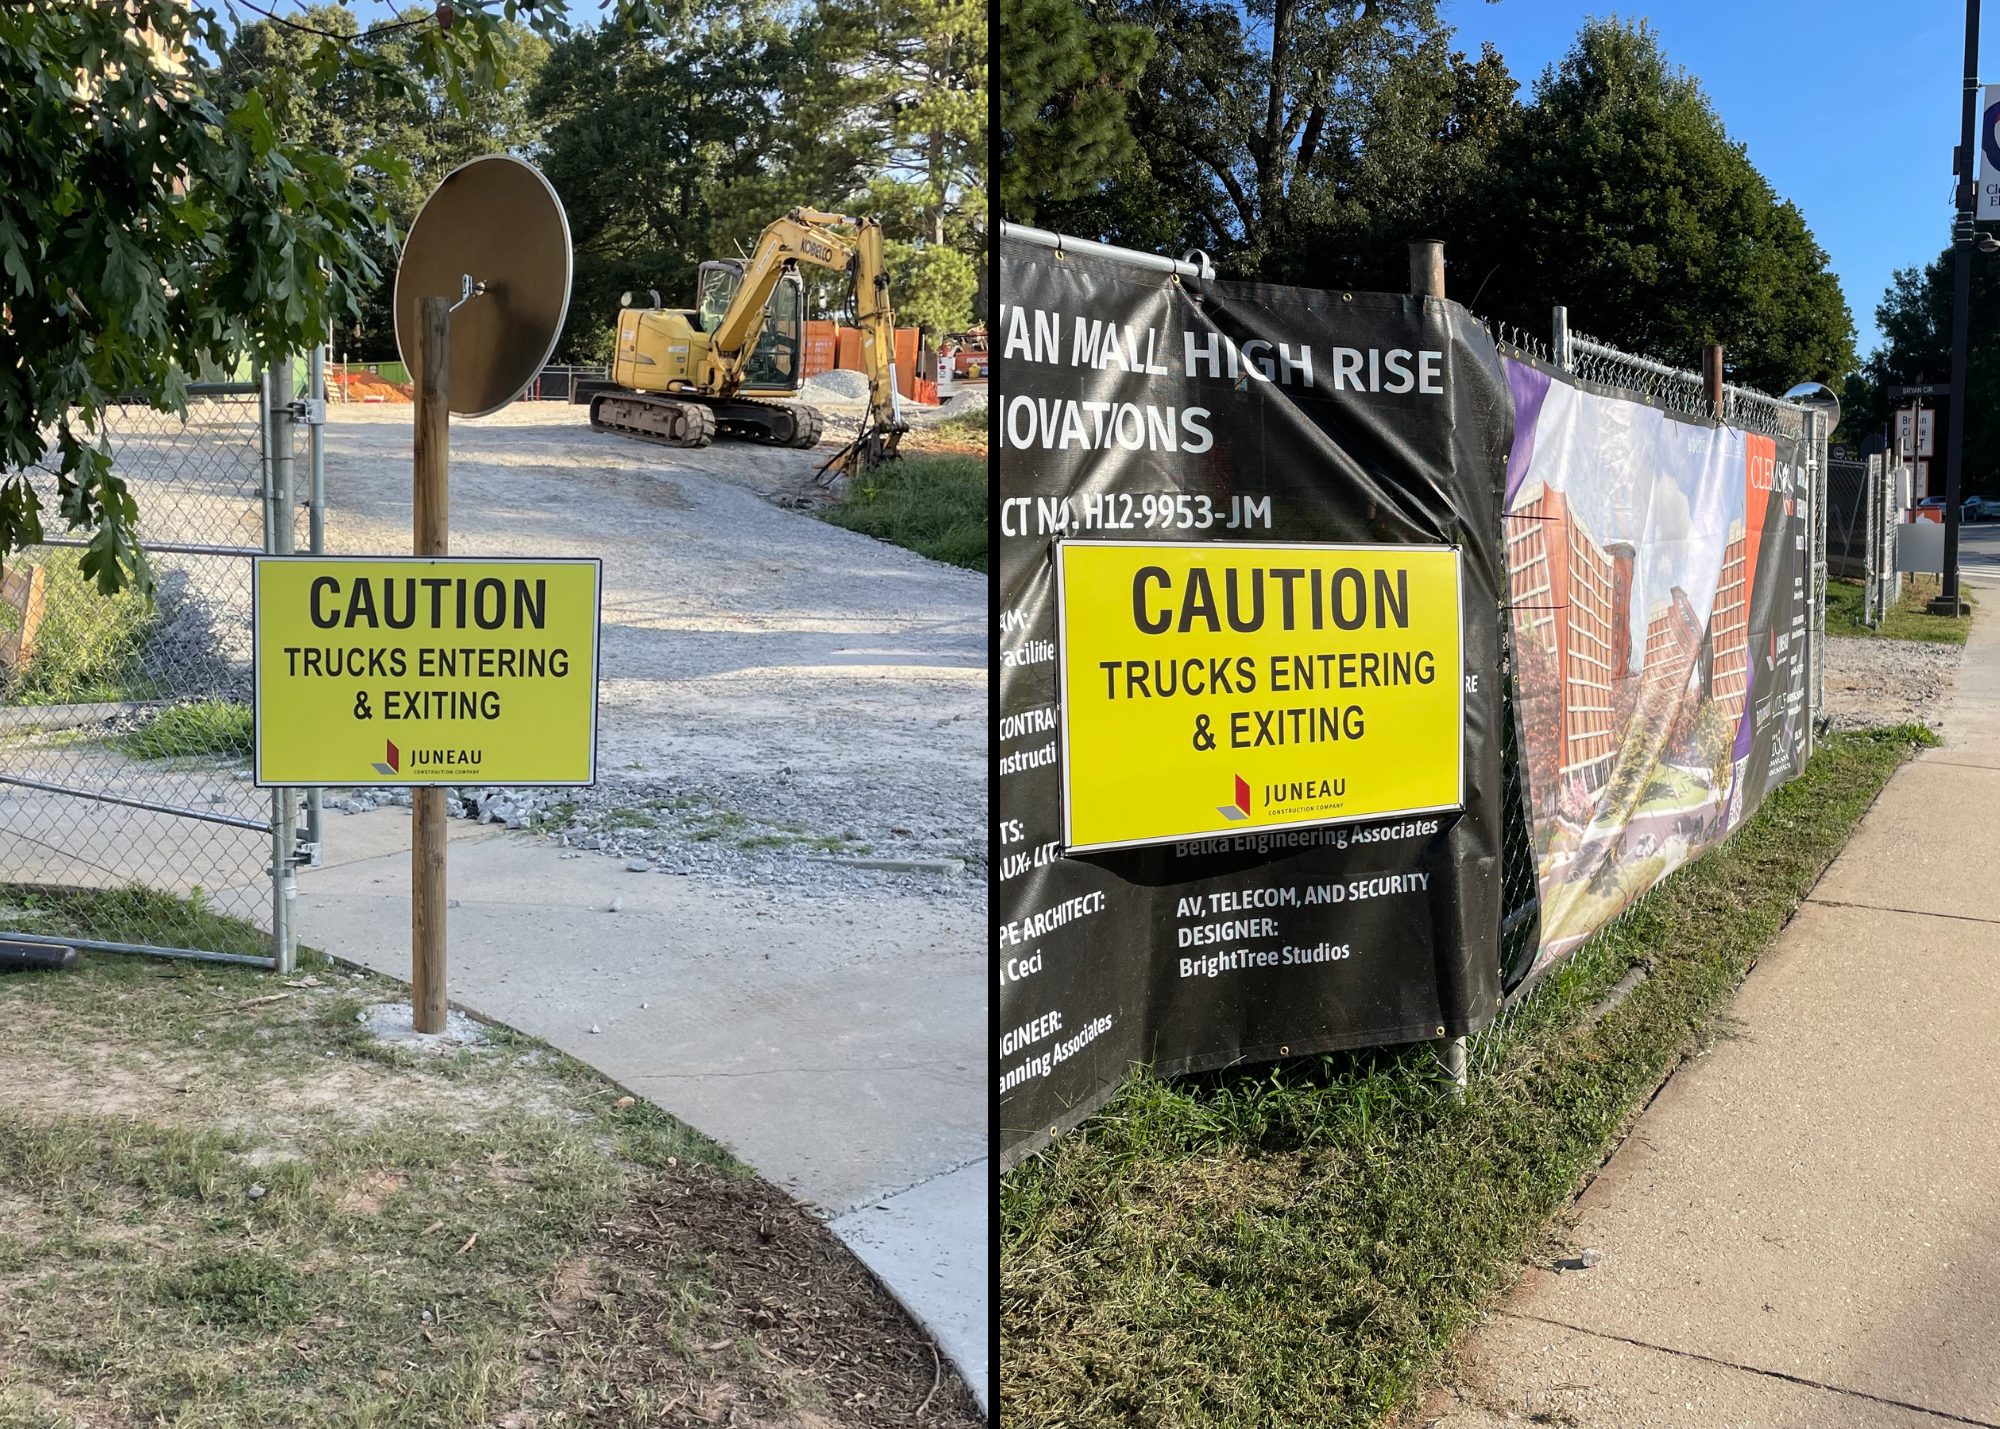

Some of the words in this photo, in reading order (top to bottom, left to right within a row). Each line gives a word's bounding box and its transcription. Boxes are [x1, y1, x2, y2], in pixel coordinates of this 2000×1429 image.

[1986, 184, 2000, 195] Cl
[800, 237, 833, 262] KOBELCO
[1000, 304, 1060, 364] AN
[1071, 316, 1168, 376] MALL
[1183, 331, 1314, 388] HIGH
[1333, 346, 1444, 394] RISE
[1902, 386, 1922, 395] BRYAN
[1902, 416, 1927, 425] Brn
[1904, 439, 1925, 451] LT
[1038, 496, 1080, 535] NO.
[1082, 494, 1272, 529] H12-9953-JM
[310, 576, 546, 629] CAUTION
[1132, 565, 1409, 635] CAUTION
[284, 647, 407, 677] TRUCKS
[418, 648, 569, 677] ENTERING
[1000, 640, 1054, 668] acilitie
[1100, 656, 1256, 699] TRUCKS
[1270, 650, 1436, 692] ENTERING
[354, 690, 373, 720] &
[384, 691, 501, 720] EXITING
[1000, 707, 1057, 742] CONTRA
[1192, 713, 1217, 751] &
[1230, 705, 1365, 748] EXITING
[410, 750, 482, 768] JUNEAU
[1264, 778, 1346, 808] JUNEAU
[1268, 806, 1314, 816] CONSTRUCTION
[1316, 802, 1344, 811] COMPANY
[1234, 827, 1348, 854] Engineering
[1351, 819, 1438, 844] Associates
[1000, 851, 1032, 882] UX+
[1176, 896, 1207, 918] AV,
[1209, 887, 1301, 912] TELECOM,
[1304, 884, 1345, 905] AND
[1348, 873, 1430, 901] SECURITY
[1023, 890, 1105, 940] ARCHITECT:
[1178, 918, 1279, 948] DESIGNER:
[1007, 948, 1042, 981] Ceci
[1179, 949, 1279, 978] BrightTree
[1282, 943, 1350, 965] Studios
[1000, 1010, 1063, 1060] GINEER:
[1053, 1014, 1112, 1066] Associates
